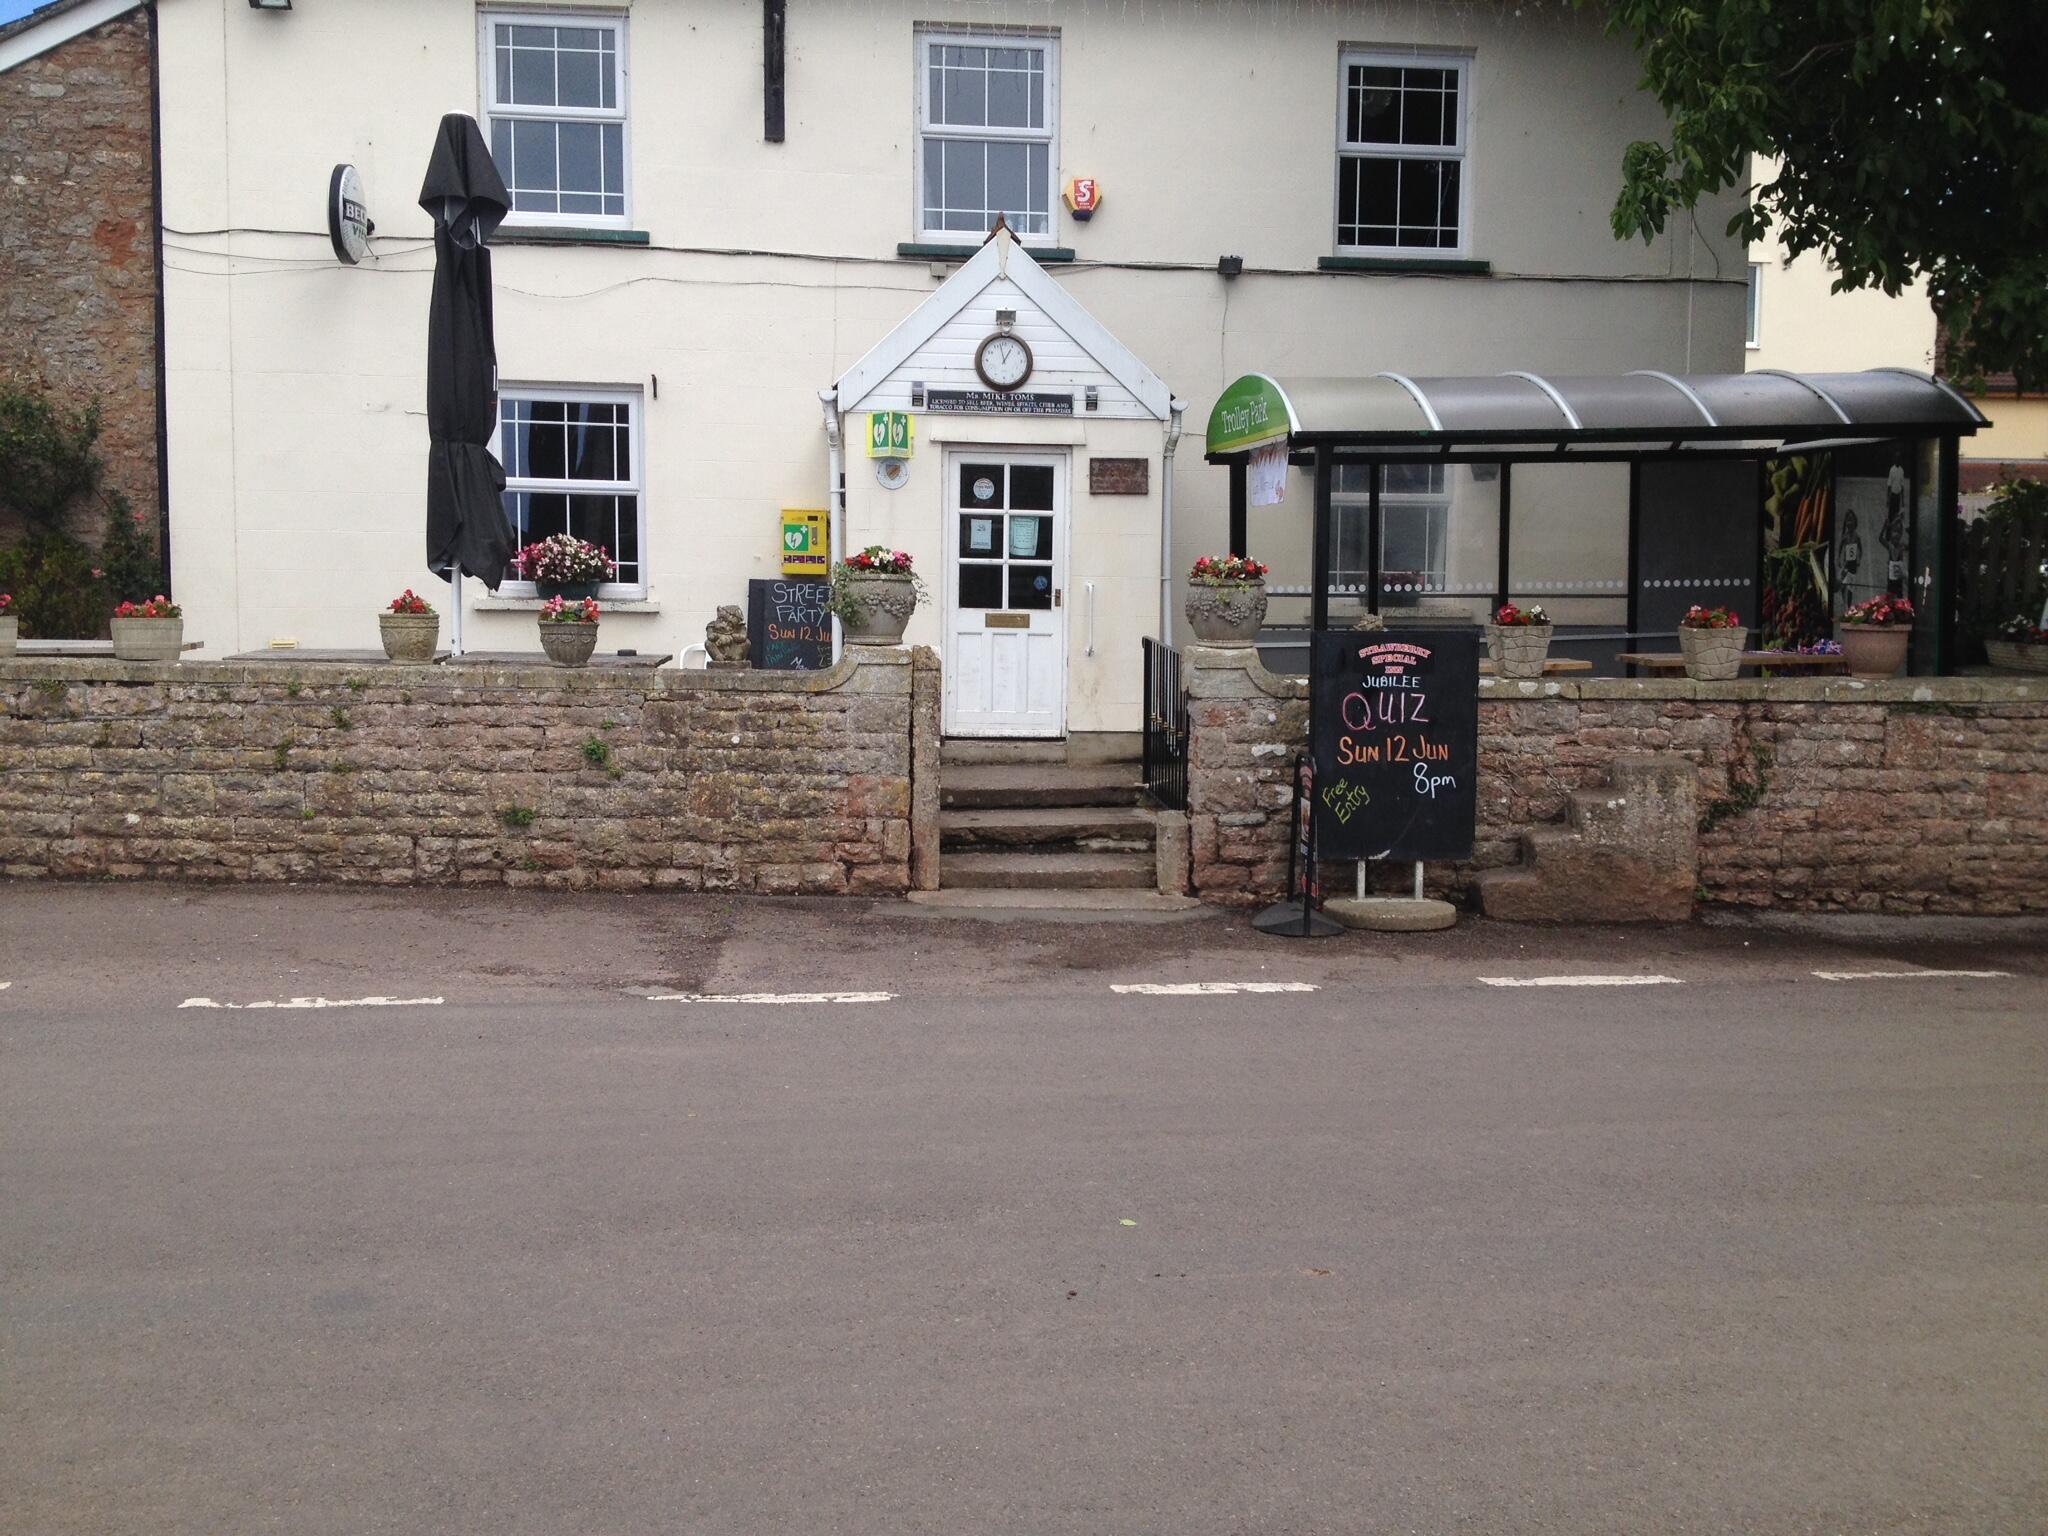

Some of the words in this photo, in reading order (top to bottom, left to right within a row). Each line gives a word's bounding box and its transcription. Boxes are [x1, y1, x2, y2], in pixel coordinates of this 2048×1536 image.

[982, 392, 1007, 400] MIKE
[1010, 393, 1034, 401] TOMS
[1221, 406, 1249, 435] Trolley
[1250, 397, 1268, 426] Park
[776, 605, 826, 627] PARTY
[800, 626, 813, 640] 12
[1371, 653, 1417, 665] SPECIAL
[1362, 675, 1421, 688] JUBILEE
[1342, 692, 1429, 729] QUIZ
[1387, 735, 1409, 762] 12
[1322, 778, 1348, 808] Free
[1413, 762, 1457, 799] 8pm
[1335, 785, 1371, 824] Entry
